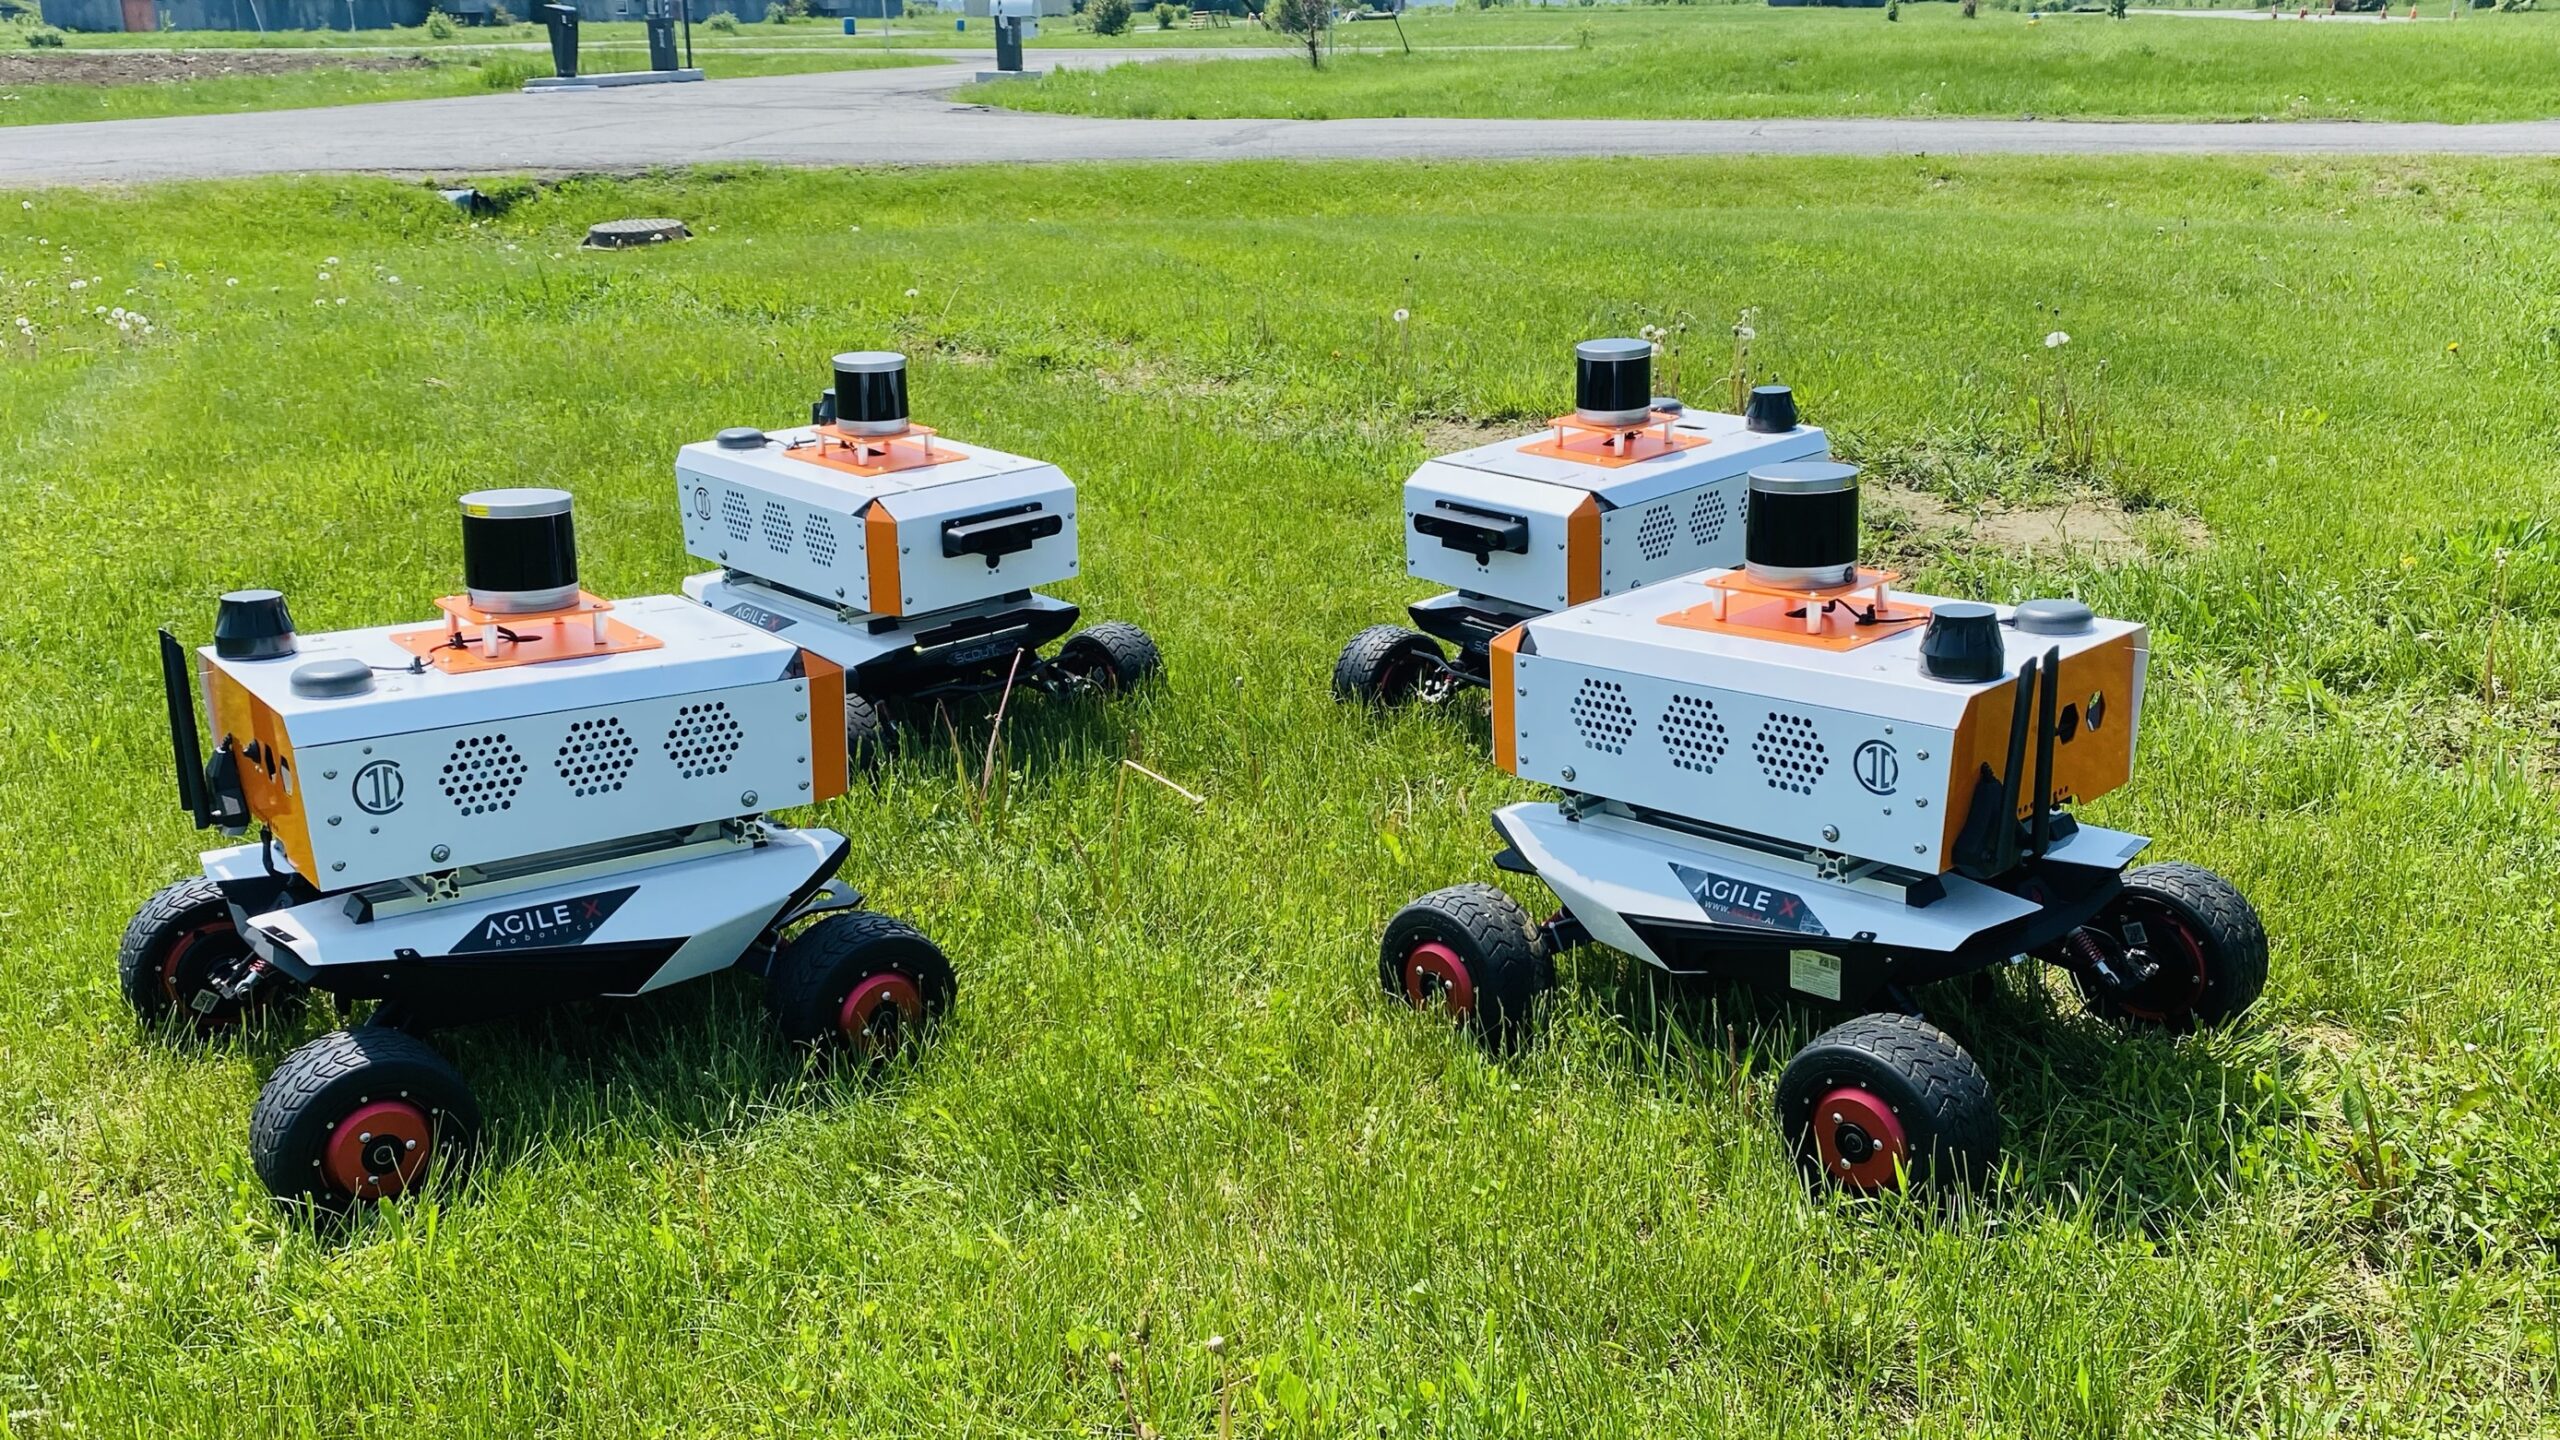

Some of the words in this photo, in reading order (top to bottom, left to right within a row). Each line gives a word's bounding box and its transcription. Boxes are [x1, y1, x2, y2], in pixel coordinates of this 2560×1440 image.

[733, 606, 768, 626] AGILE
[768, 616, 779, 630] X
[1694, 877, 1772, 912] AGILE
[1778, 897, 1799, 919] X
[486, 904, 572, 940] AGILE
[582, 899, 602, 920] X
[495, 921, 595, 947] Robotics
